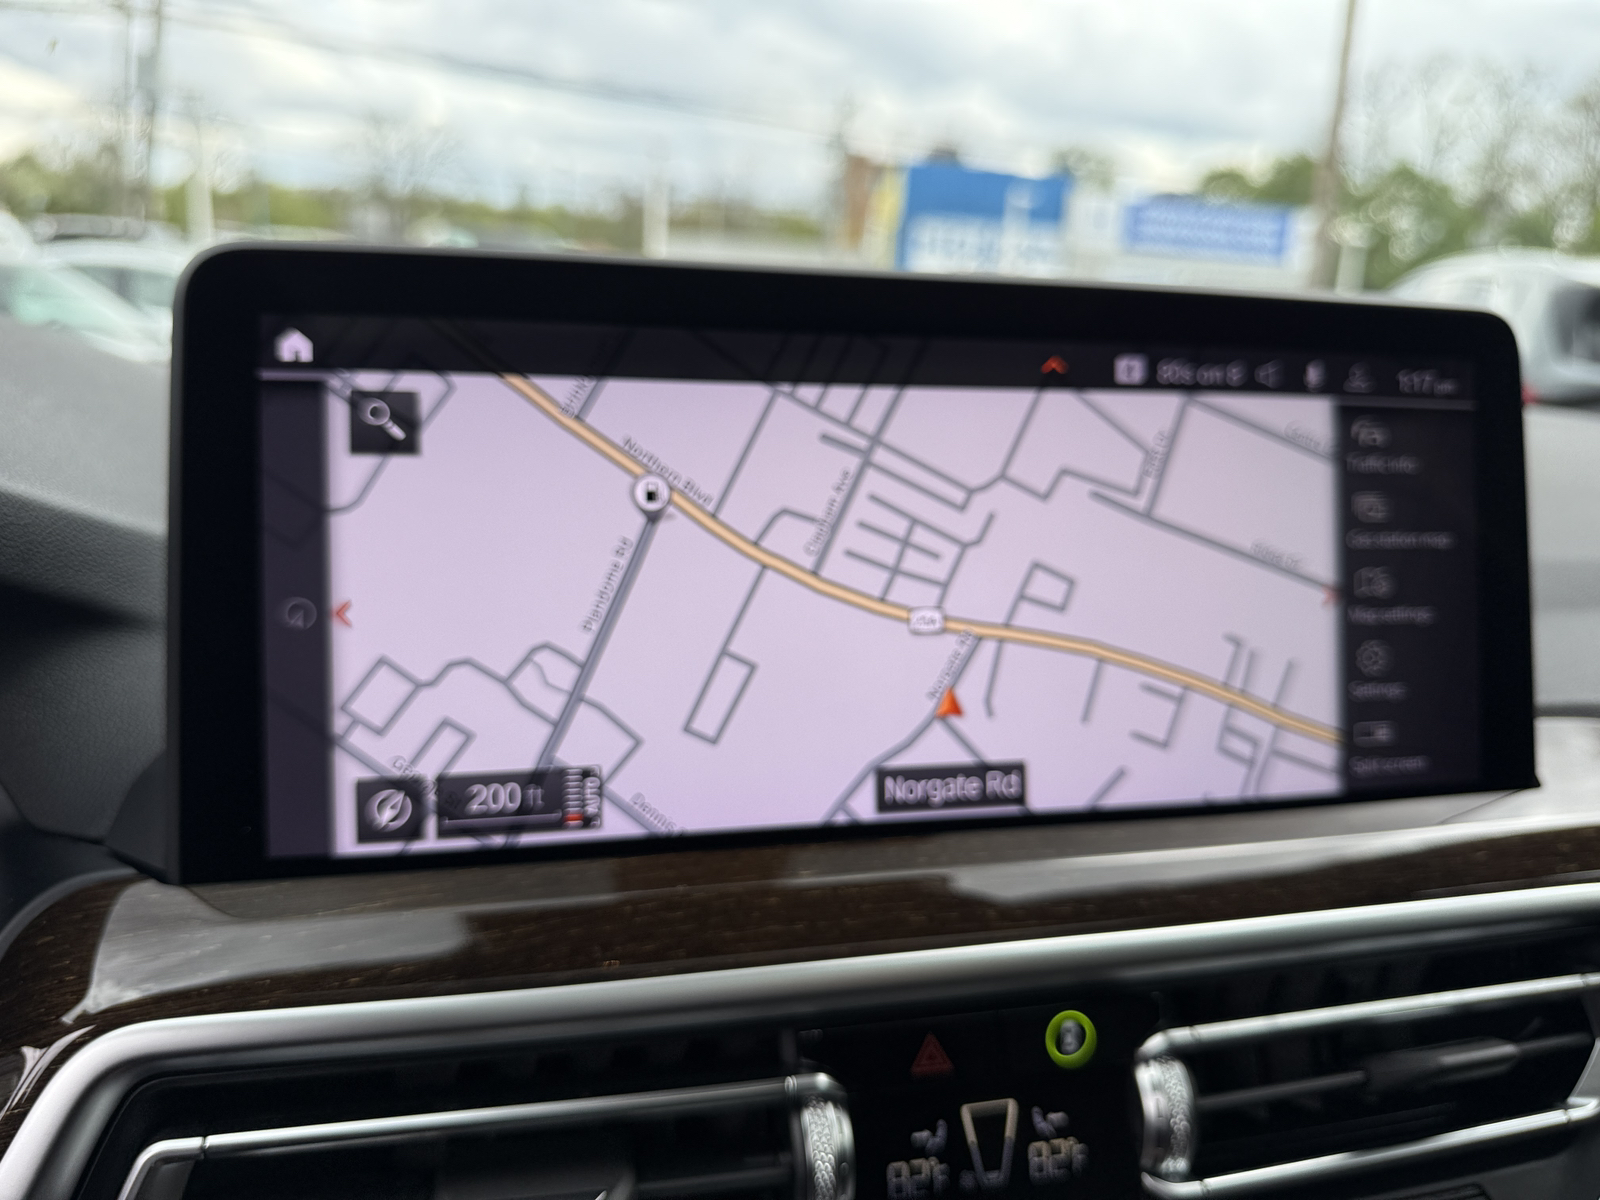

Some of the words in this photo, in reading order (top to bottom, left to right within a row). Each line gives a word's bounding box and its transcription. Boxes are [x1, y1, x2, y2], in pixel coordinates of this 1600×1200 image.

[624, 436, 684, 484] Northern
[682, 476, 714, 507] Blvd
[464, 781, 521, 815] 200
[521, 784, 546, 812] ft
[884, 773, 984, 809] Norgate
[984, 769, 1022, 801] Rd
